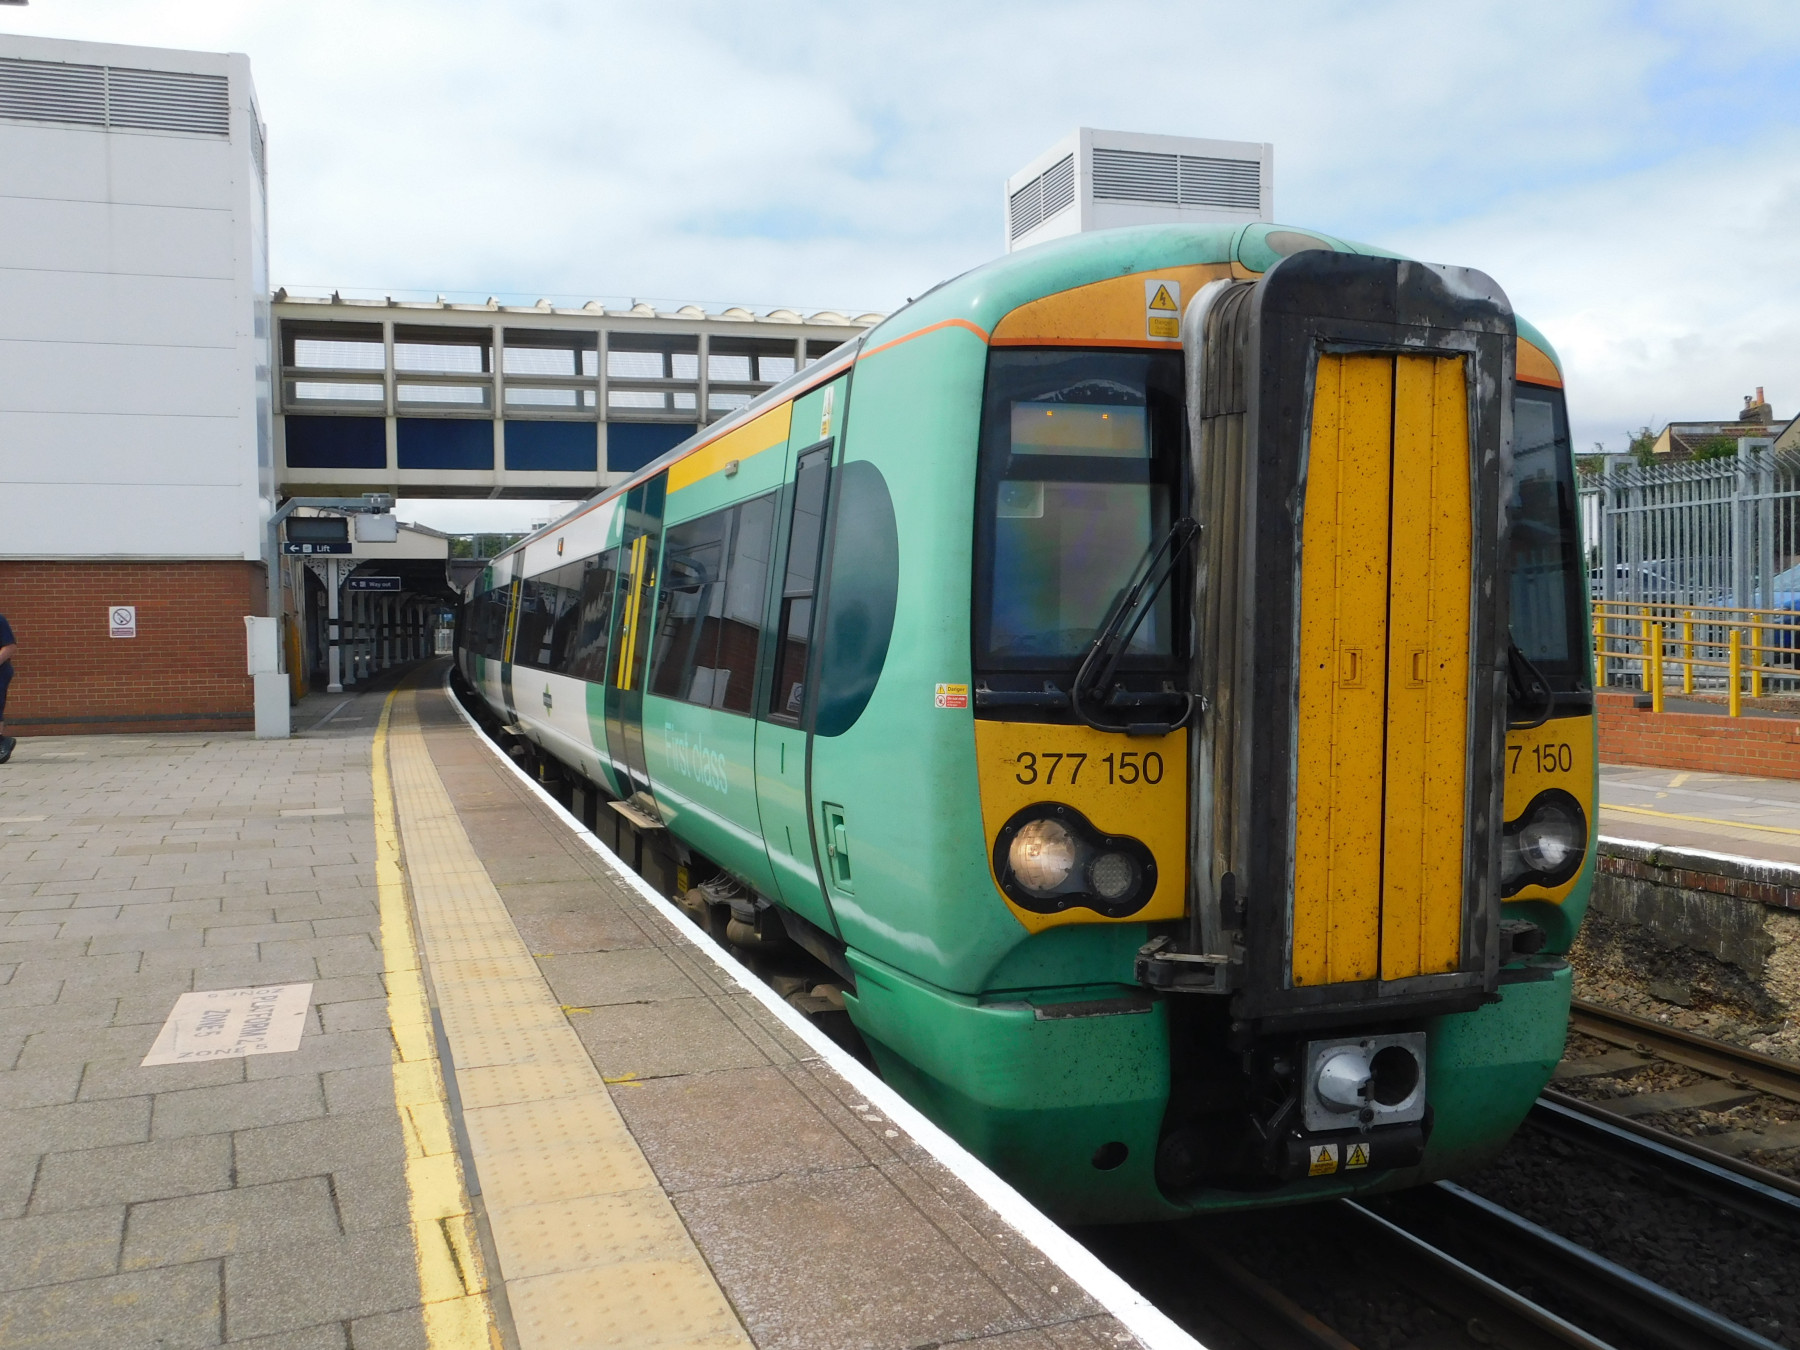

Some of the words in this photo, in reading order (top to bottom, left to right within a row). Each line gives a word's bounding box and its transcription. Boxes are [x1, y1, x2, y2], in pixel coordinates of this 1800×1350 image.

[665, 722, 691, 778] First
[693, 732, 728, 795] class
[1015, 752, 1088, 785] 377
[1102, 752, 1164, 785] 150
[1532, 743, 1572, 773] 150
[195, 1008, 231, 1031] ZONE
[239, 995, 278, 1037] PLATFORM
[236, 1037, 264, 1046] 2
